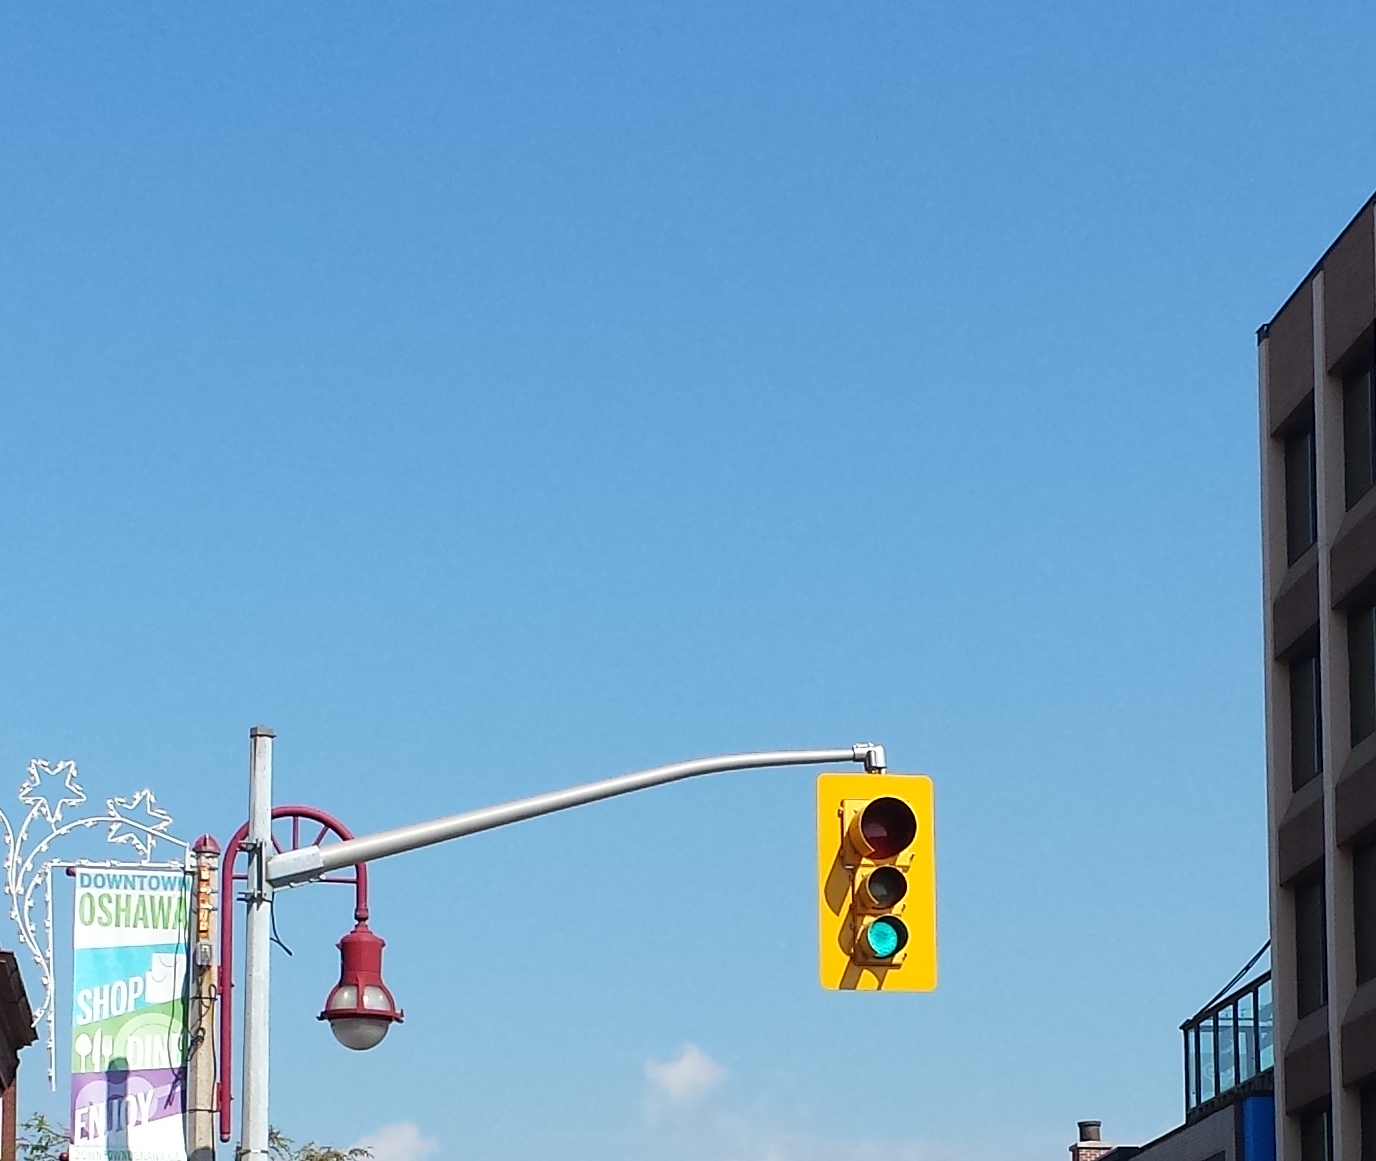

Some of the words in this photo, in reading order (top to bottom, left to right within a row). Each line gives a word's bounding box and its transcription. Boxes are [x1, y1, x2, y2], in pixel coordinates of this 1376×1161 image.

[80, 872, 191, 892] DOWNTOWN
[79, 891, 188, 930] OSHAWA
[76, 975, 144, 1025] SHOP
[74, 1089, 155, 1141] ENJOY
